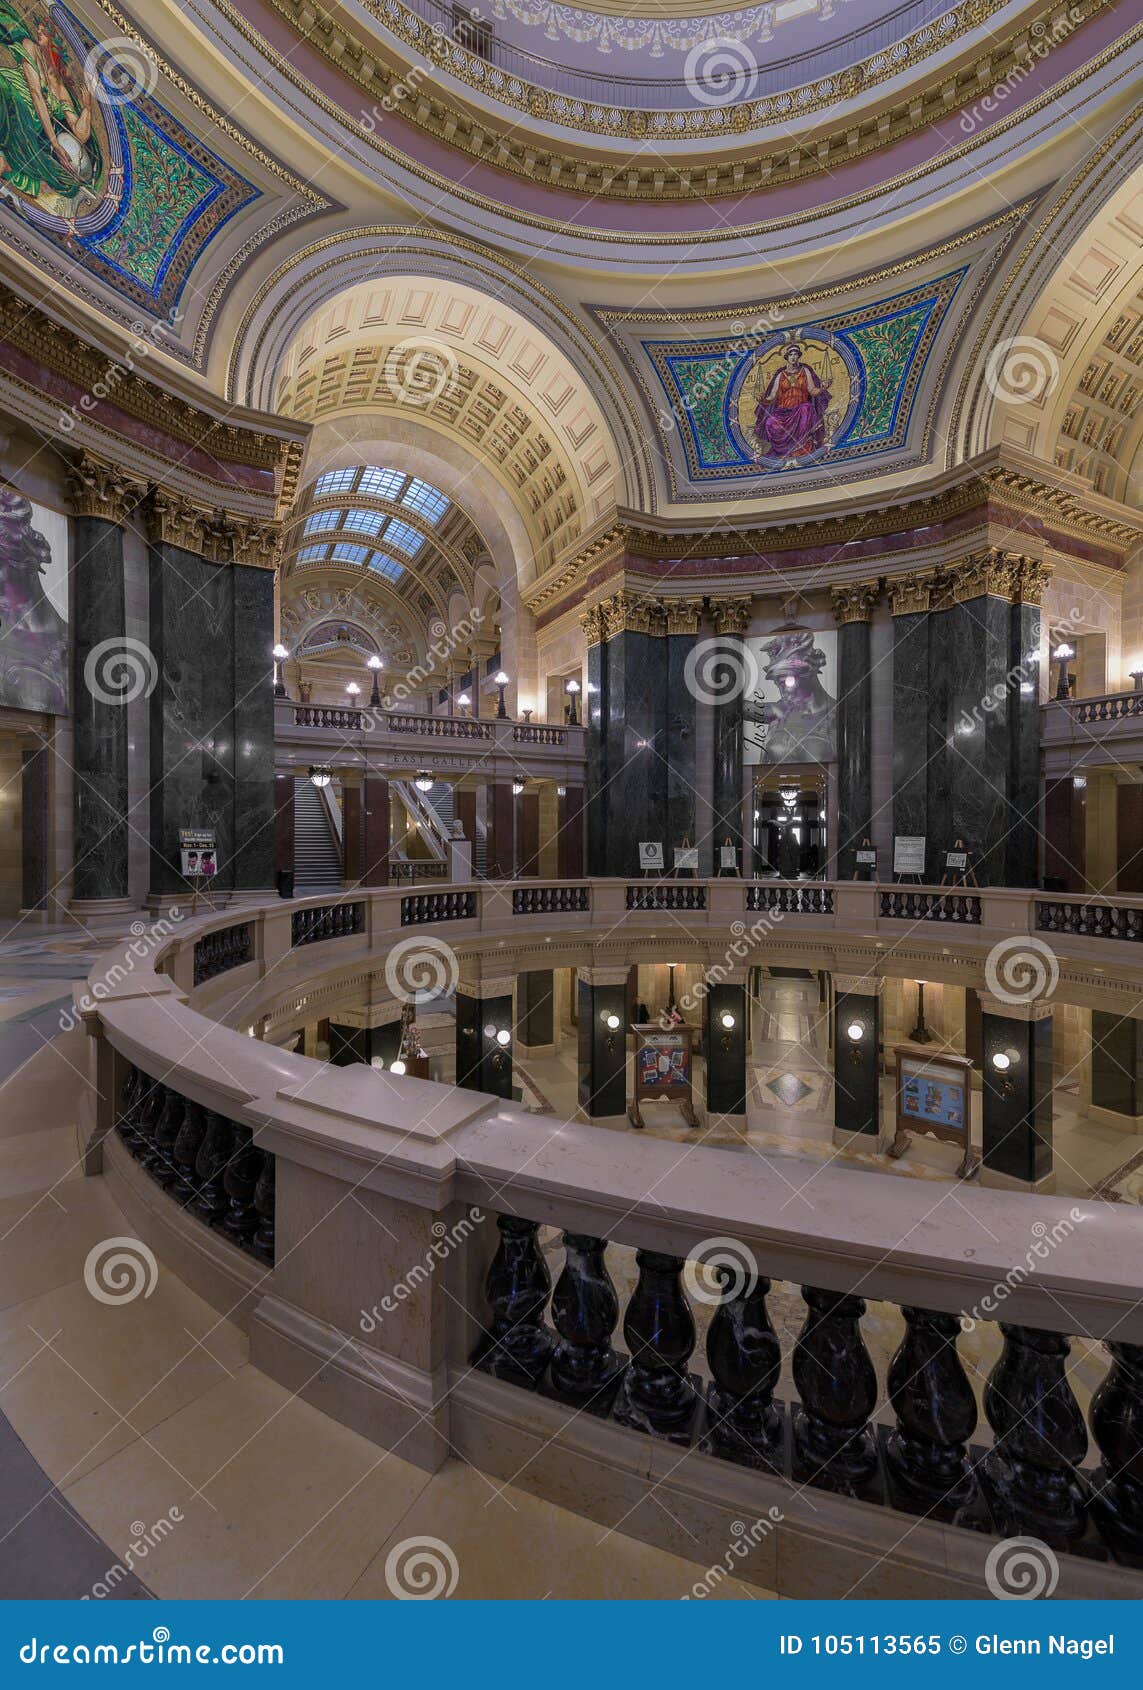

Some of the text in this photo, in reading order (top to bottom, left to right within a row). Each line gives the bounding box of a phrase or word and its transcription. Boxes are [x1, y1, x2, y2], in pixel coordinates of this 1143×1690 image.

[743, 687, 769, 753] Justice
[393, 754, 489, 767] EAST GALLERY
